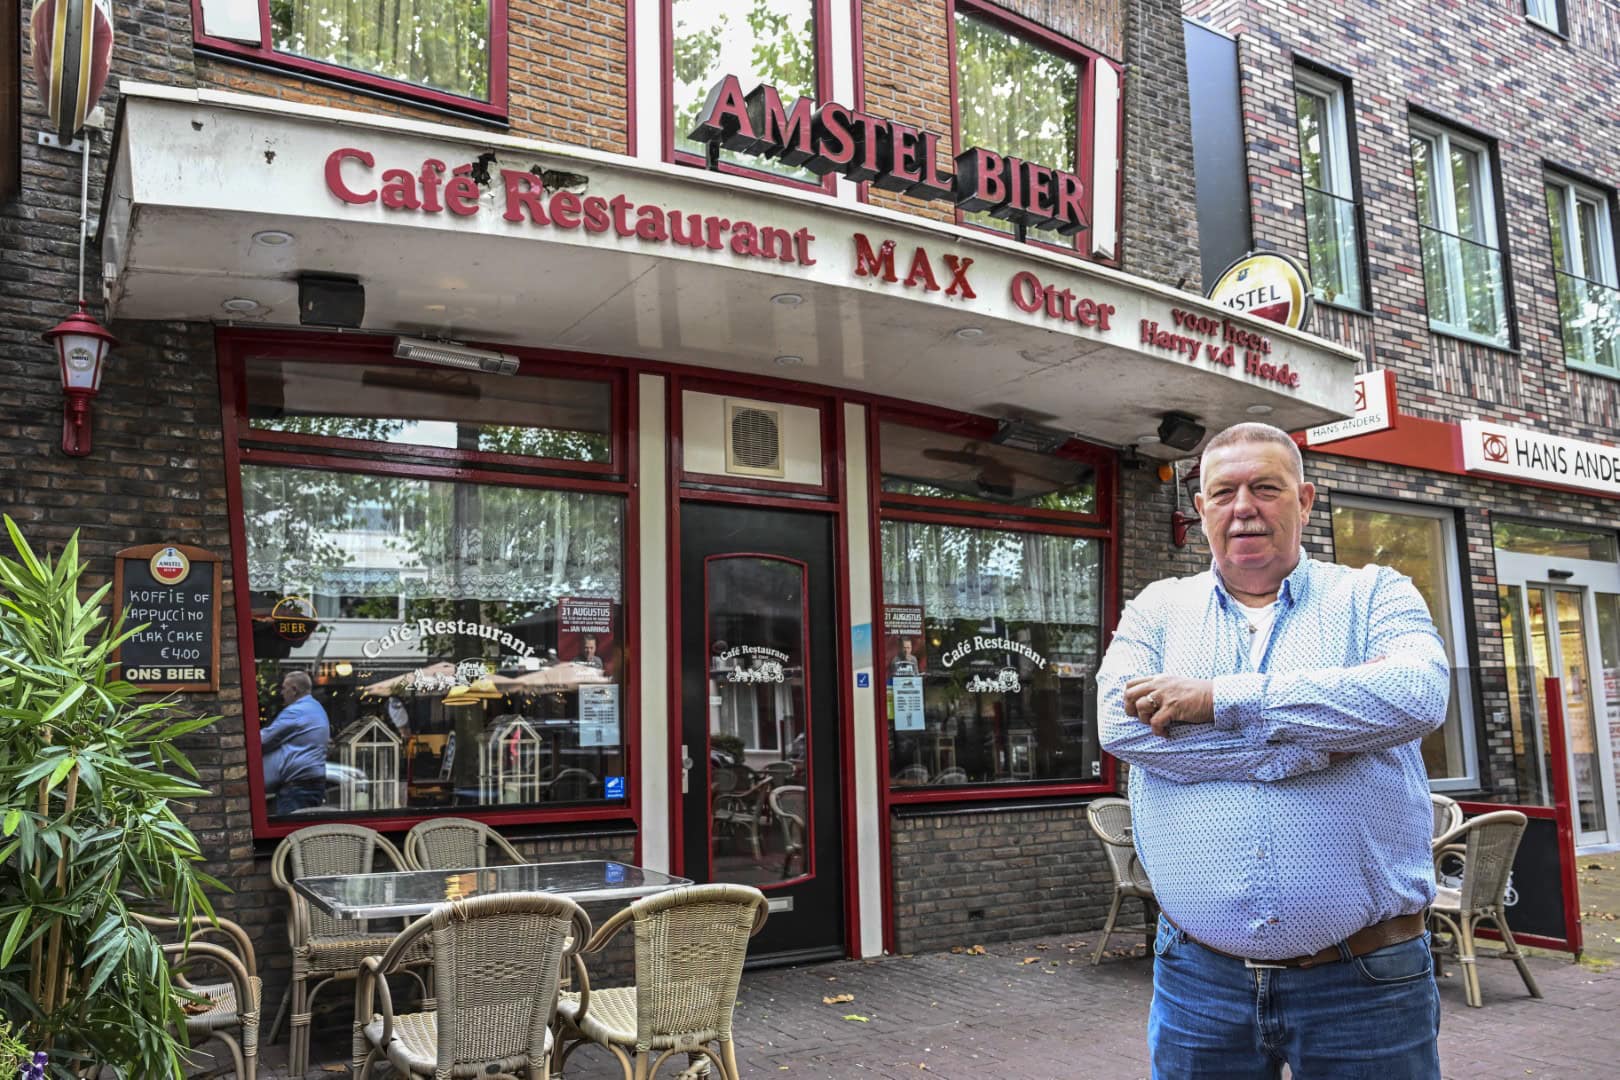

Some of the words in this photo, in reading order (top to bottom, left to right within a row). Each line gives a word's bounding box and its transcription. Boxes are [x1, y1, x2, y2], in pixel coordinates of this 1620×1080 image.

[692, 74, 954, 198] AMSTEL
[960, 146, 1089, 233] BIER
[325, 148, 480, 217] Café
[500, 168, 817, 266] Restaurant
[852, 232, 978, 300] MAX
[1011, 271, 1116, 331] Otter
[1223, 285, 1281, 311] MSTEL
[1140, 319, 1202, 362] Harry
[1312, 425, 1340, 438] HANS
[1342, 414, 1381, 430] ANDERS
[1515, 438, 1568, 474] HANS
[194, 594, 210, 604] OF
[572, 607, 610, 617] AUGUSTUS
[167, 631, 204, 643] CAKE
[279, 623, 306, 633] BIER
[362, 622, 413, 659] Café
[417, 617, 536, 660] Restaurant
[720, 646, 741, 661] Café
[742, 645, 790, 663] Restaurant
[942, 640, 972, 668] Café
[973, 636, 1047, 670] Restaurant
[126, 668, 162, 681] ONS
[167, 668, 206, 681] BIER
